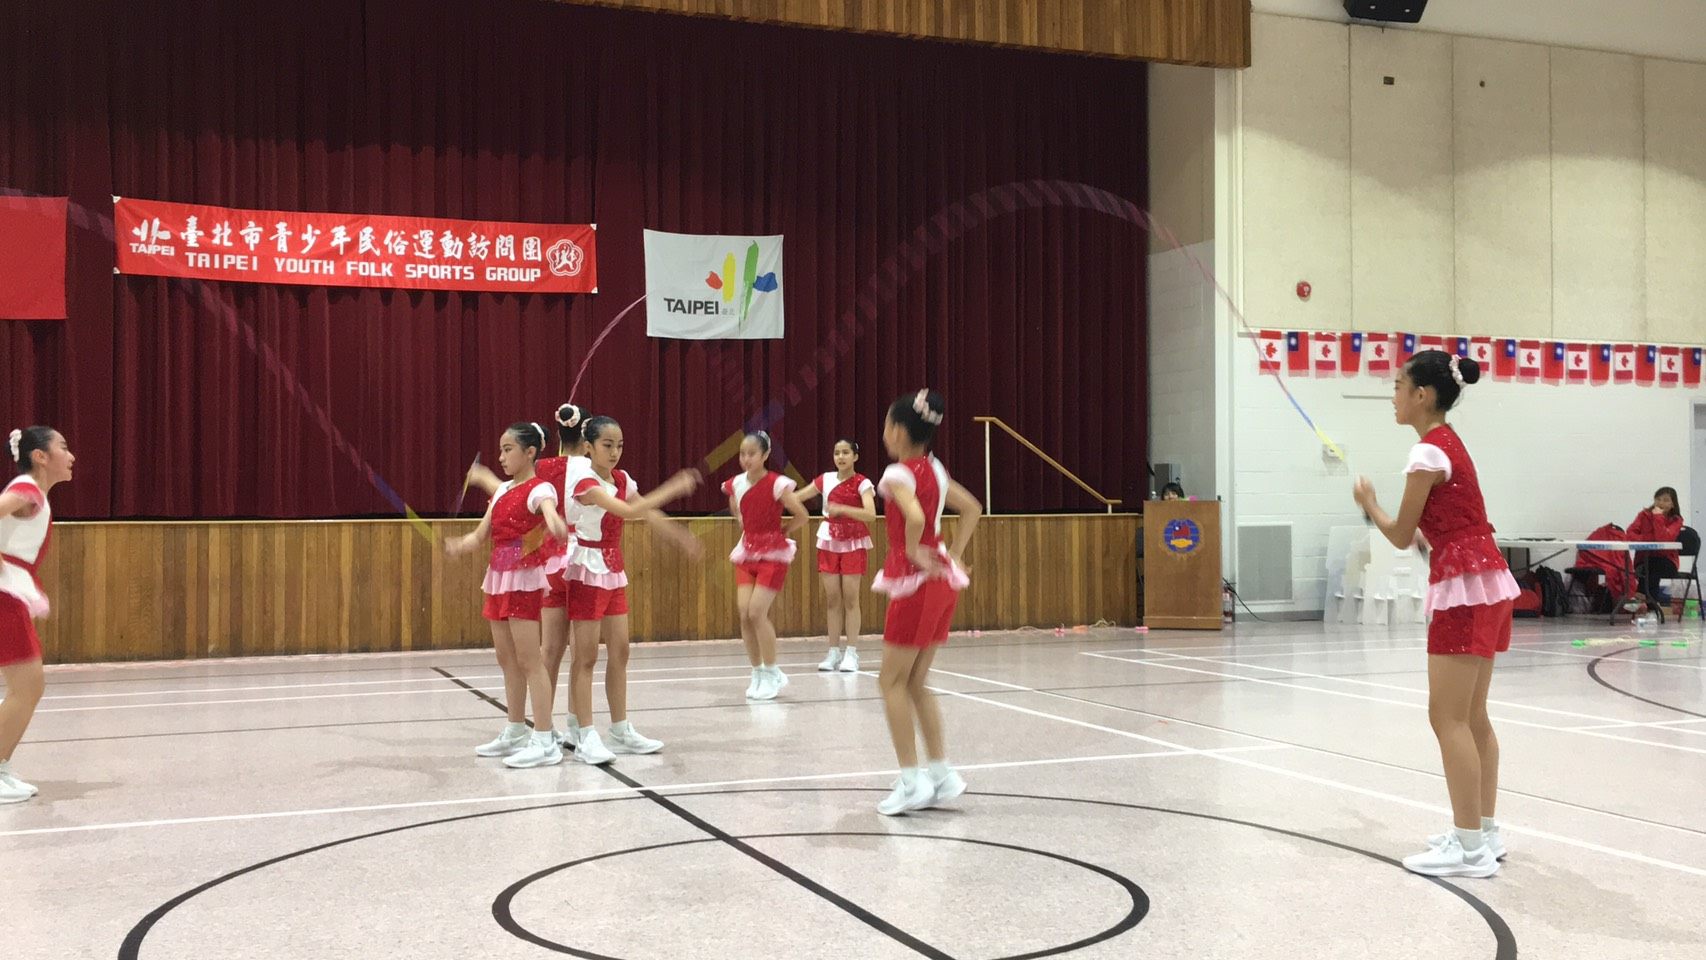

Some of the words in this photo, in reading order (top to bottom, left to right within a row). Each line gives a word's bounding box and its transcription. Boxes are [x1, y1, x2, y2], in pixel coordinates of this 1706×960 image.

[129, 243, 175, 257] TAIPEI
[180, 215, 542, 262] 臺北市青少年民俗運動訪問團
[185, 252, 258, 271] TAIPEI
[274, 257, 335, 275] YOUTH
[346, 260, 393, 278] FOLK
[405, 262, 475, 281] SPORTS
[485, 266, 541, 283] GROUP
[664, 297, 719, 315] TAIPEI
